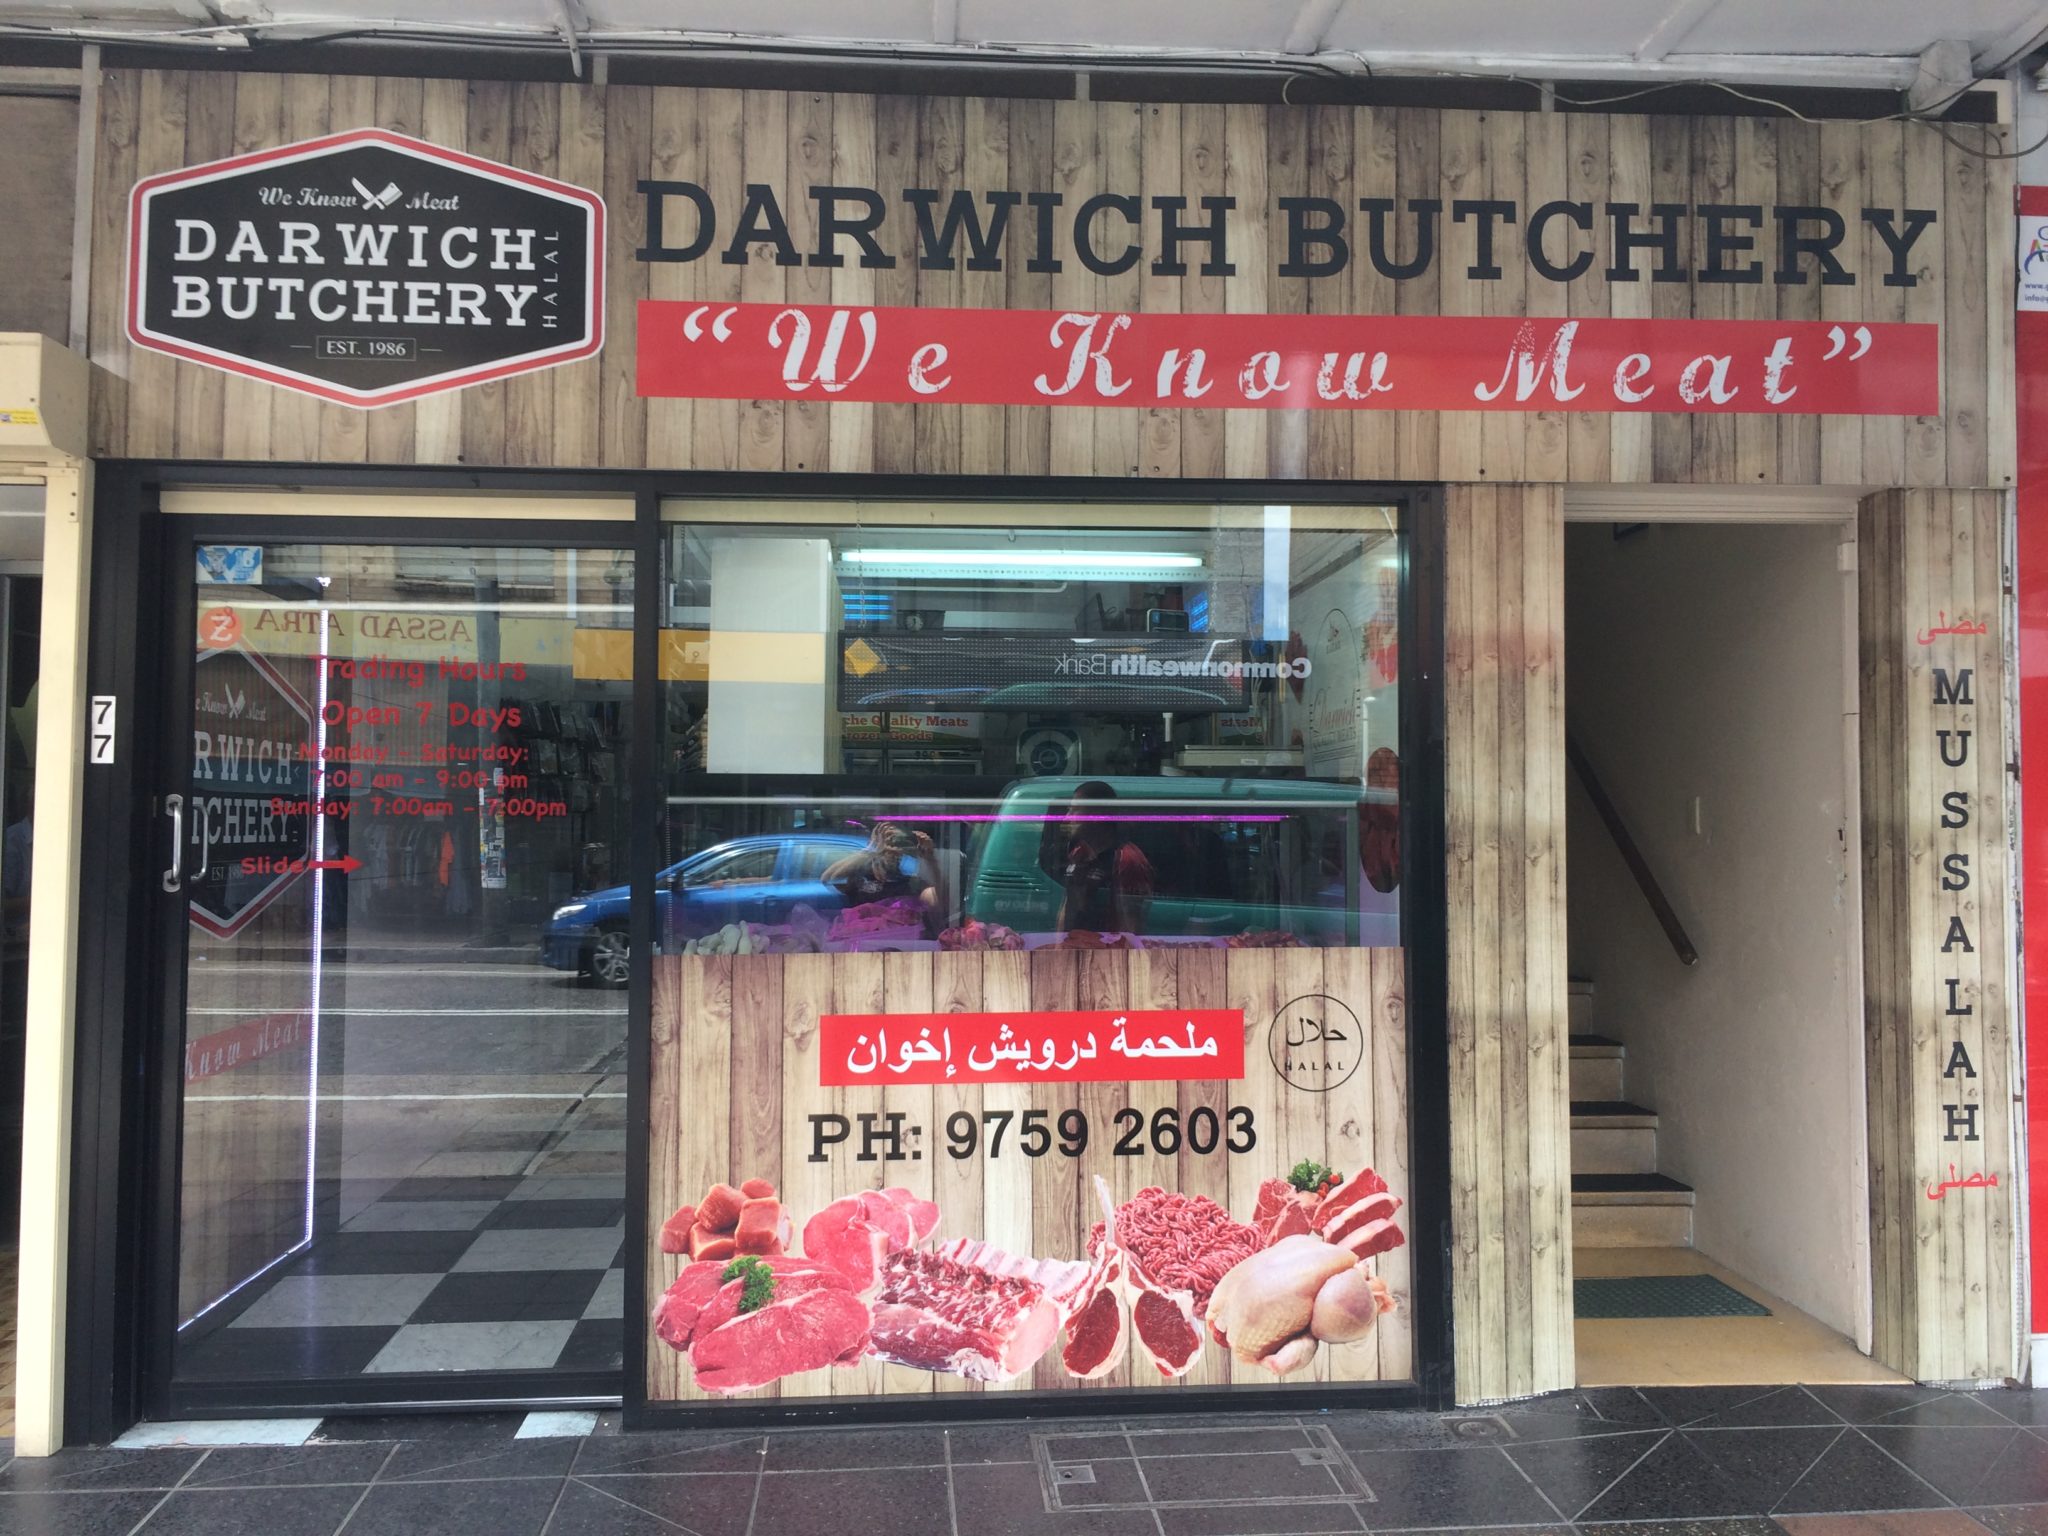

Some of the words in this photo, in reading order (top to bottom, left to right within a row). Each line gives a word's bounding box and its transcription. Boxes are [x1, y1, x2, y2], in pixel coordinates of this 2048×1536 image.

[259, 186, 292, 206] We
[297, 187, 358, 208] Know
[406, 191, 459, 211] Meat
[174, 219, 537, 271] DARWICH
[636, 179, 1237, 277] DARWICH
[1277, 196, 1938, 287] BUTCHERY
[543, 230, 559, 328] HALAL
[171, 275, 538, 327] BUTCHERY
[326, 340, 362, 355] EST.
[369, 341, 406, 357] 1986
[1034, 312, 1394, 401] Know
[308, 654, 425, 688] Trading
[439, 656, 527, 681] Hours
[322, 700, 400, 733] Open
[416, 702, 433, 725] 7
[450, 702, 522, 733] Days
[872, 715, 922, 728] Qality
[193, 731, 293, 785] RWICH
[300, 742, 389, 764] Monday
[420, 743, 529, 764] Saturday:
[311, 770, 362, 788] 7:00
[372, 774, 404, 788] am
[436, 770, 488, 788] 9:00
[497, 774, 528, 794] pm
[271, 797, 359, 820] Sunday:
[371, 799, 453, 816] 7:00am
[487, 798, 567, 822] 7:00pm
[240, 856, 304, 874] Slide
[968, 1023, 1097, 1070] درويش
[1110, 1017, 1218, 1059] ملحمة
[1285, 1017, 1348, 1048] حلال
[847, 1027, 956, 1078] إخوان
[1285, 1062, 1346, 1071] HALAL
[808, 1112, 922, 1162] PH:
[945, 1109, 1089, 1158] 9759
[1113, 1106, 1257, 1155] 2603
